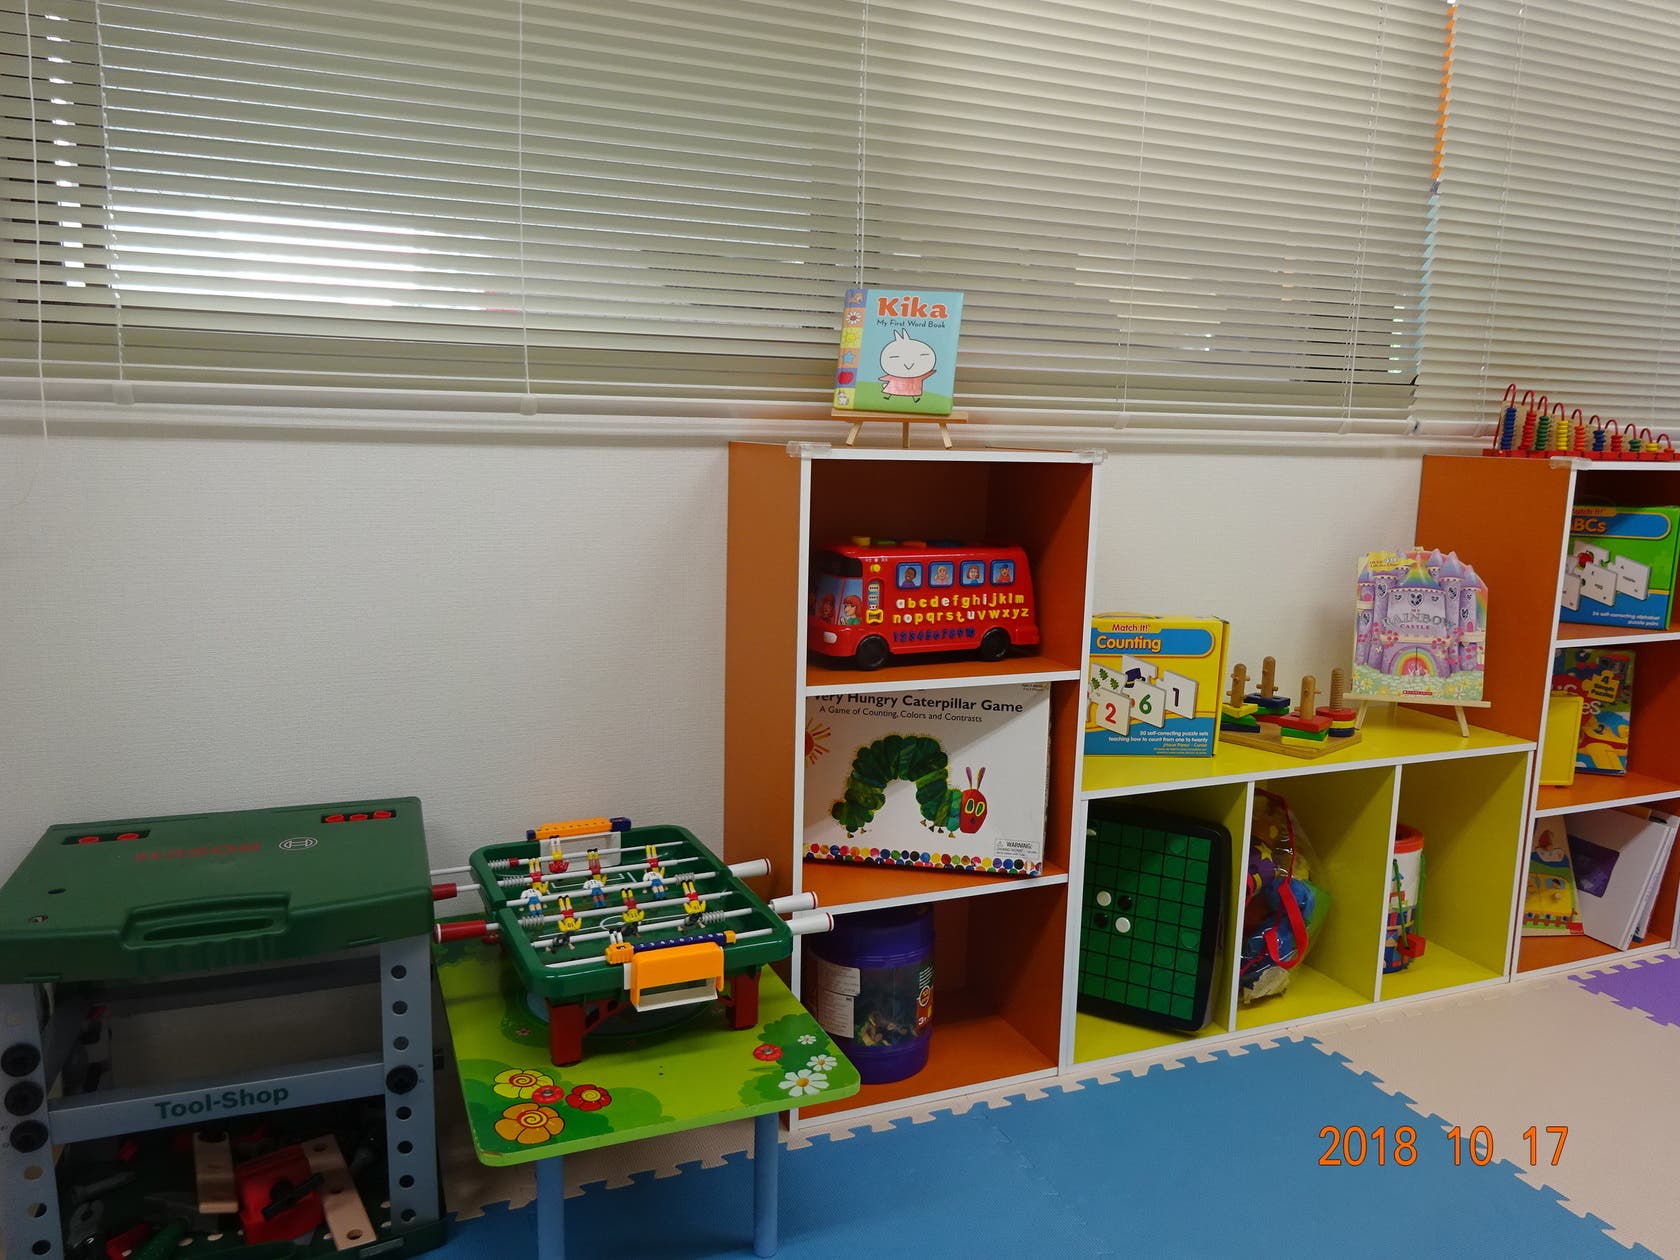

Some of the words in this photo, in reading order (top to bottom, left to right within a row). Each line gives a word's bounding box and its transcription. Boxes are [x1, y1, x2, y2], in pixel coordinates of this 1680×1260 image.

[877, 296, 949, 319] Kika
[1572, 517, 1607, 533] BCs
[1111, 623, 1138, 632] Match
[1140, 624, 1149, 632] It!
[1096, 635, 1162, 653] Counting
[847, 693, 898, 708] Hungry
[902, 695, 977, 711] Caterpillar
[981, 700, 1024, 712] Game
[1138, 693, 1153, 715] 6
[1172, 687, 1180, 708] 1
[828, 706, 850, 714] Game
[862, 708, 899, 719] Counting,
[900, 711, 927, 719] Colors
[928, 712, 942, 720] and
[944, 713, 983, 722] Contrasts
[1104, 702, 1117, 725] 2
[154, 1087, 289, 1119] Tool-Shop
